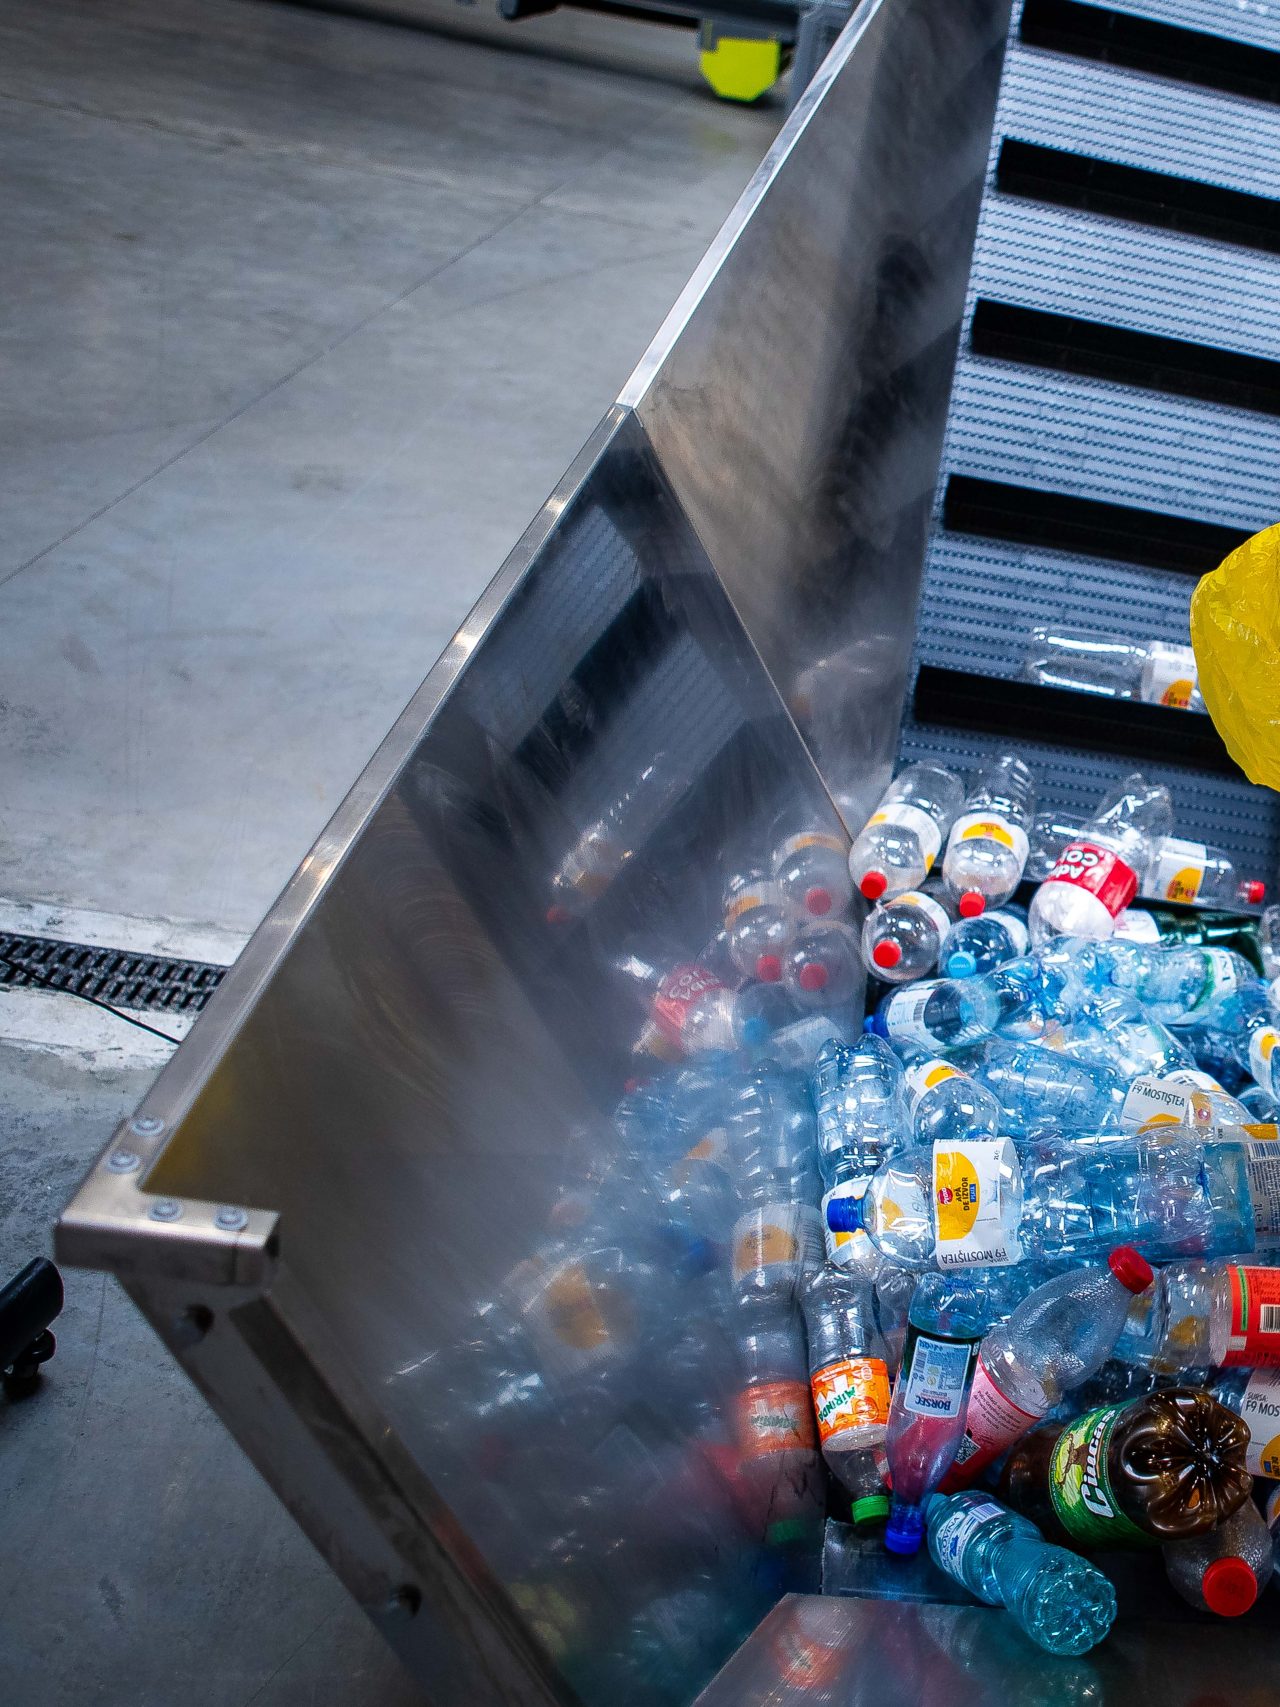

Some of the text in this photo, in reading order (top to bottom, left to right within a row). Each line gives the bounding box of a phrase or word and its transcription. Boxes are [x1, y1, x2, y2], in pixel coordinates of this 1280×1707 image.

[1131, 1084, 1143, 1095] F9
[961, 1177, 970, 1211] DE IZVOR
[995, 1247, 1006, 1258] F9
[817, 1387, 856, 1423] MIRINDA
[914, 1395, 952, 1411] BORSEC
[1245, 1399, 1258, 1413] F9
